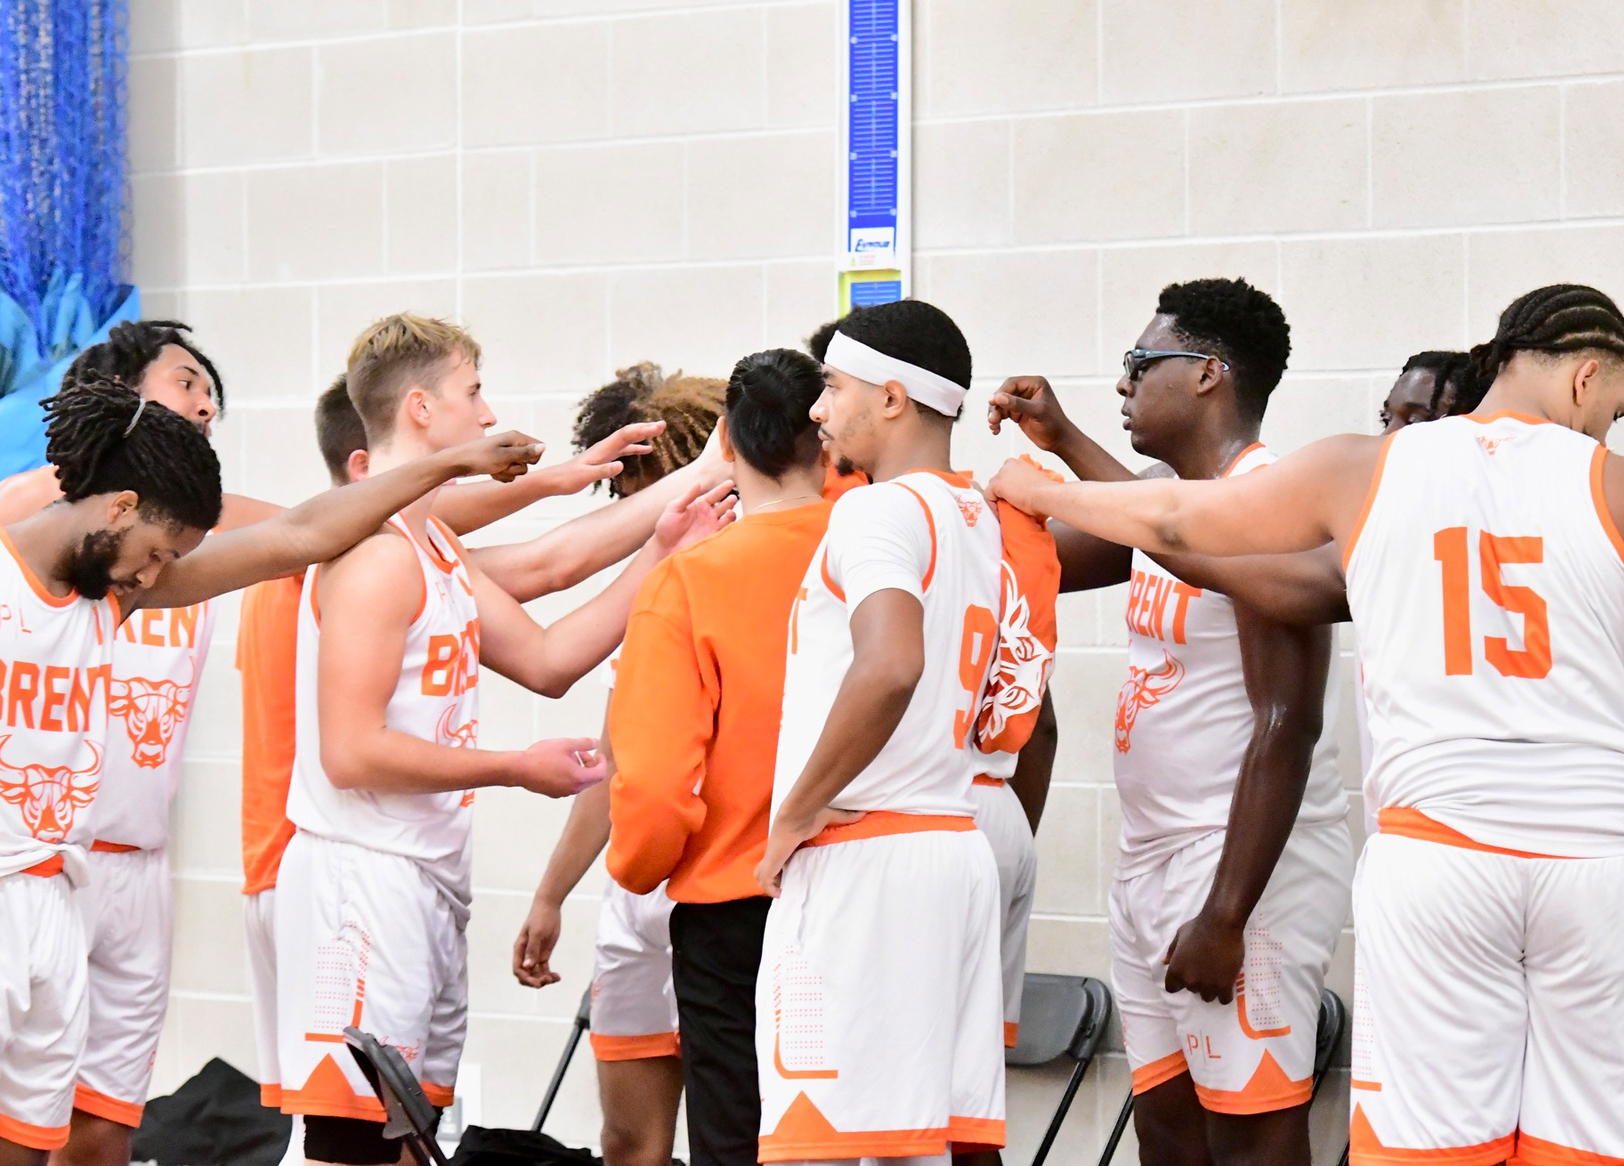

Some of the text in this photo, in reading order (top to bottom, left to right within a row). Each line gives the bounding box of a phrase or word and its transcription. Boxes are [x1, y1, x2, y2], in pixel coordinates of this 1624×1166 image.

[1126, 568, 1202, 645] RENT
[1434, 526, 1553, 680] 15
[0, 658, 113, 732] RENT
[953, 603, 998, 750] 9
